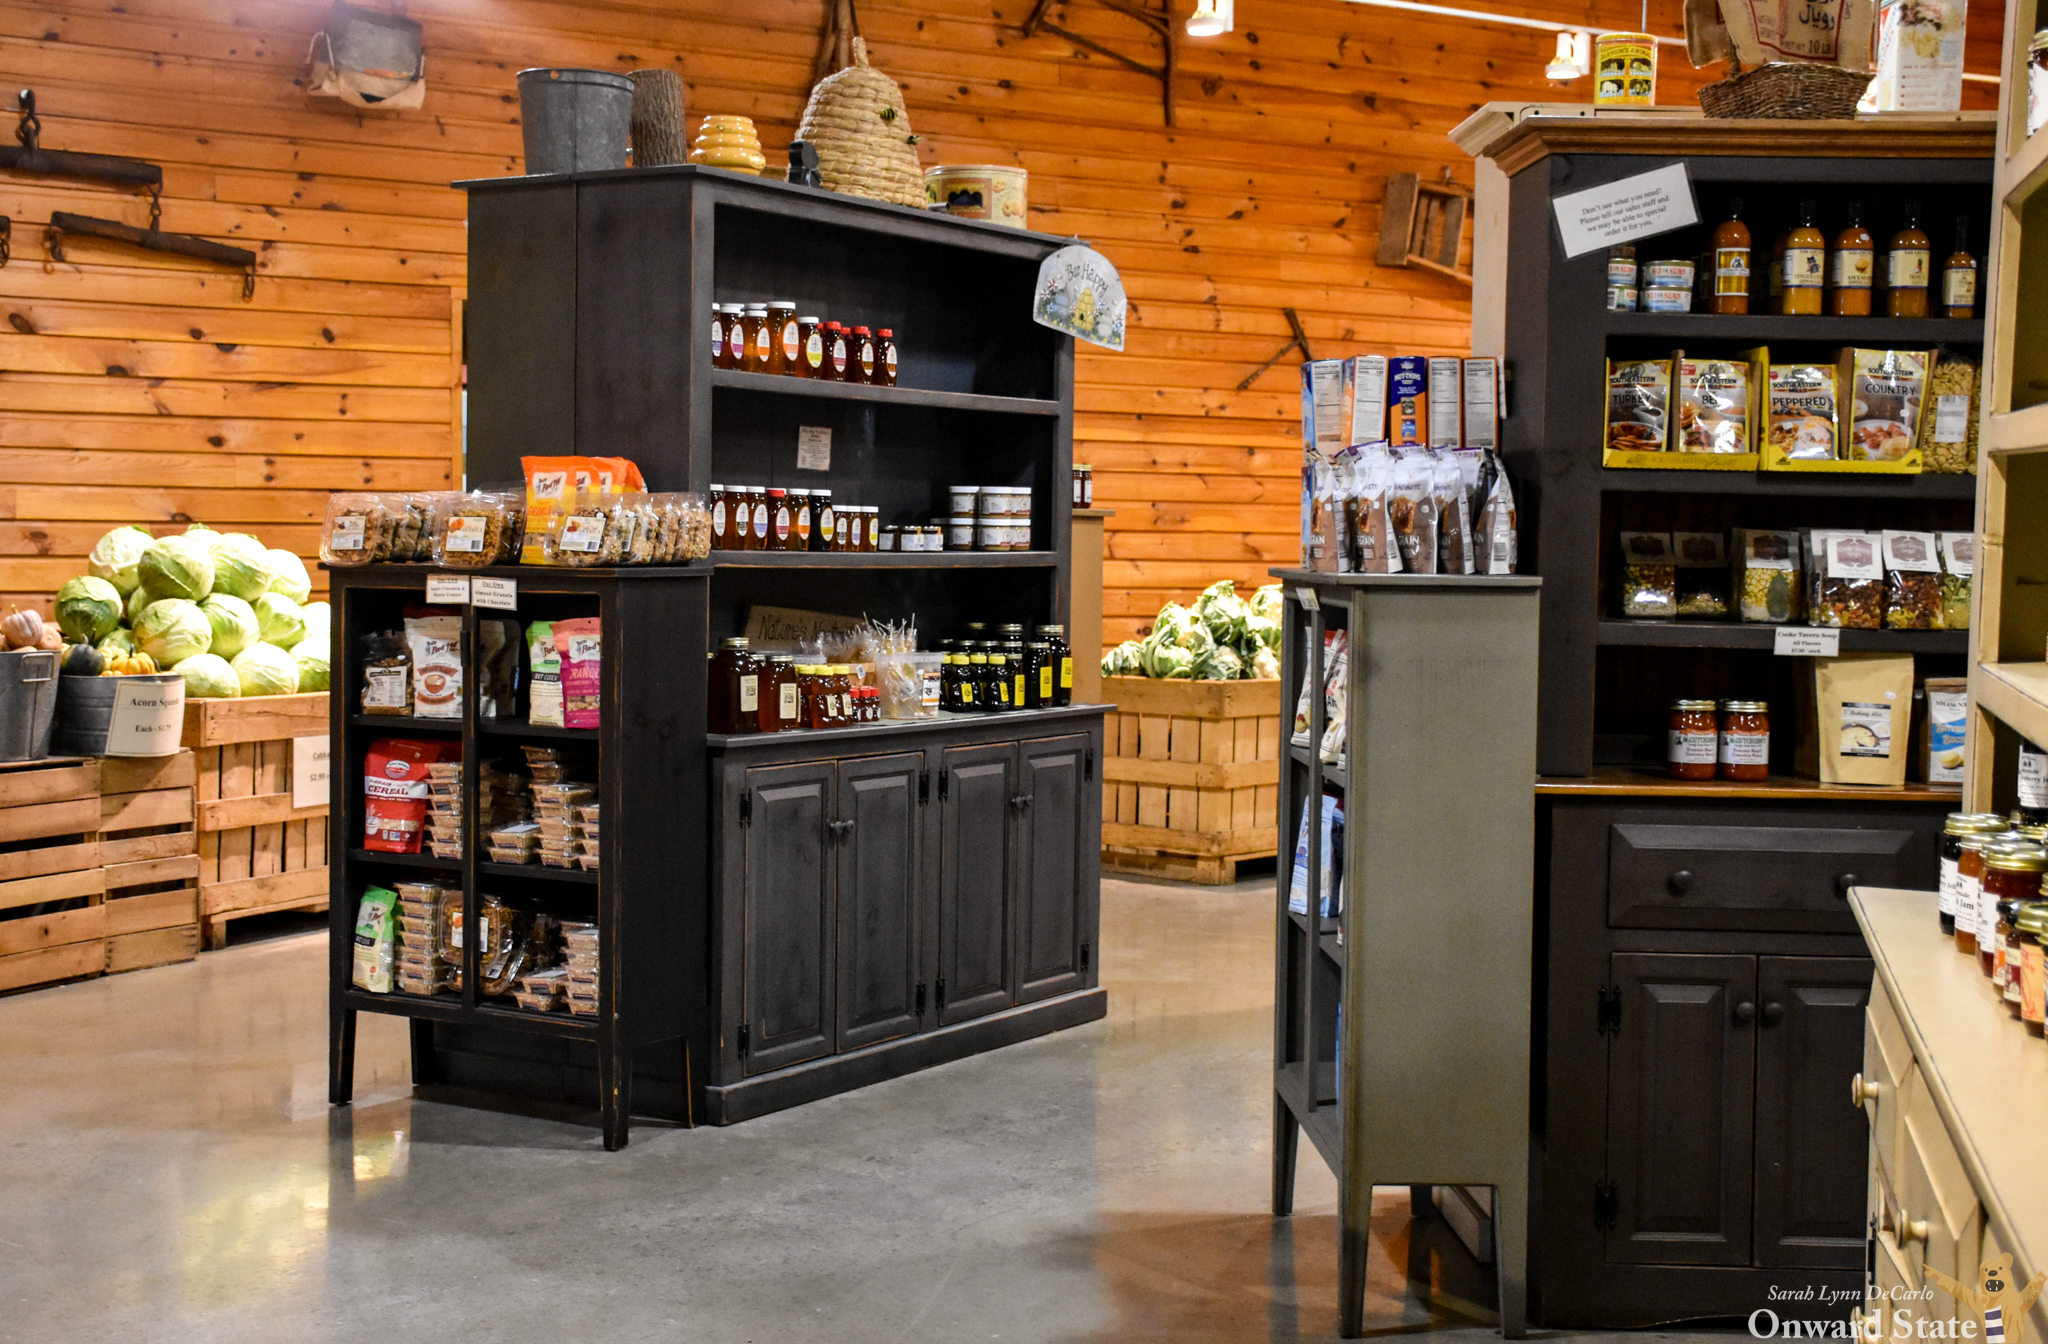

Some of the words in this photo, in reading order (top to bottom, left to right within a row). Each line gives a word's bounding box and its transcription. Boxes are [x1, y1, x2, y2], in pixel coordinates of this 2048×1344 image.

[1808, 40, 1820, 53] 10
[1582, 204, 1601, 215] Don't
[1614, 198, 1629, 206] what
[1630, 195, 1643, 204] you
[1644, 187, 1662, 198] need?
[1580, 215, 1600, 225] Please
[1601, 211, 1612, 219] tell
[1613, 208, 1624, 216] our
[1625, 204, 1641, 212] sales
[1642, 198, 1657, 207] staff
[1657, 195, 1670, 204] and
[1597, 221, 1612, 230] may
[1612, 218, 1621, 226] be
[1622, 214, 1635, 222] able
[1644, 205, 1667, 217] special
[1604, 228, 1621, 237] order
[1628, 222, 1638, 231] for
[1638, 220, 1653, 229] you.
[1081, 262, 1109, 298] Happy
[1865, 383, 1916, 396] COUNTRY
[1612, 394, 1651, 405] TURKEY
[1773, 397, 1826, 407] PEPPERED
[759, 615, 808, 641] Nature's
[129, 698, 157, 707] Acorn
[368, 785, 409, 795] CEREAL
[1960, 899, 1974, 910] Jam
